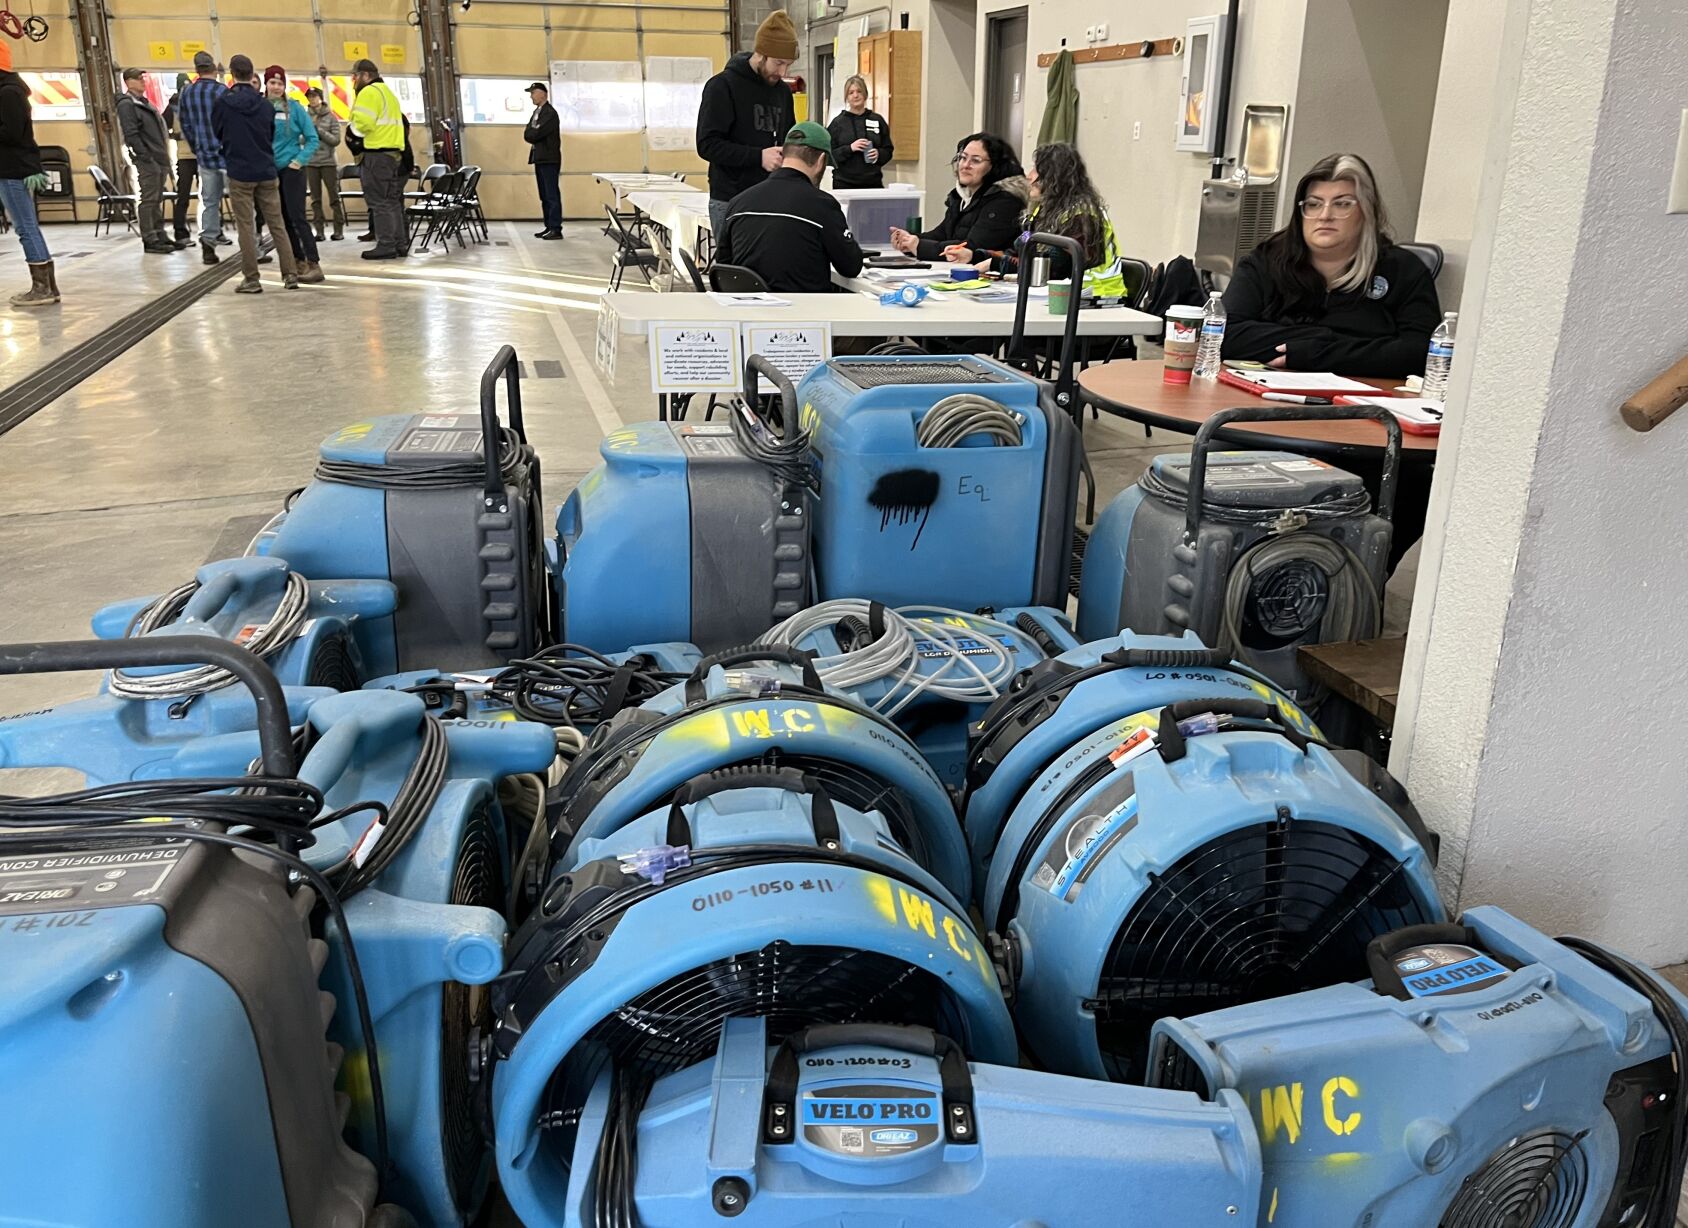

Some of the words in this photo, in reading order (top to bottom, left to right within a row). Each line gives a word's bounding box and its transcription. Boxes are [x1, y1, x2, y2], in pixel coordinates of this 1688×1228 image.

[158, 46, 166, 56] 3
[353, 47, 359, 55] 4
[1057, 804, 1129, 888] STEALTH
[43, 850, 178, 868] DEHUMIDIFIER
[691, 879, 794, 912] 0110-1050
[1448, 961, 1497, 981] VELO
[1408, 973, 1452, 991] PRO
[811, 1103, 874, 1119] VELO
[880, 1103, 931, 1119] PRO
